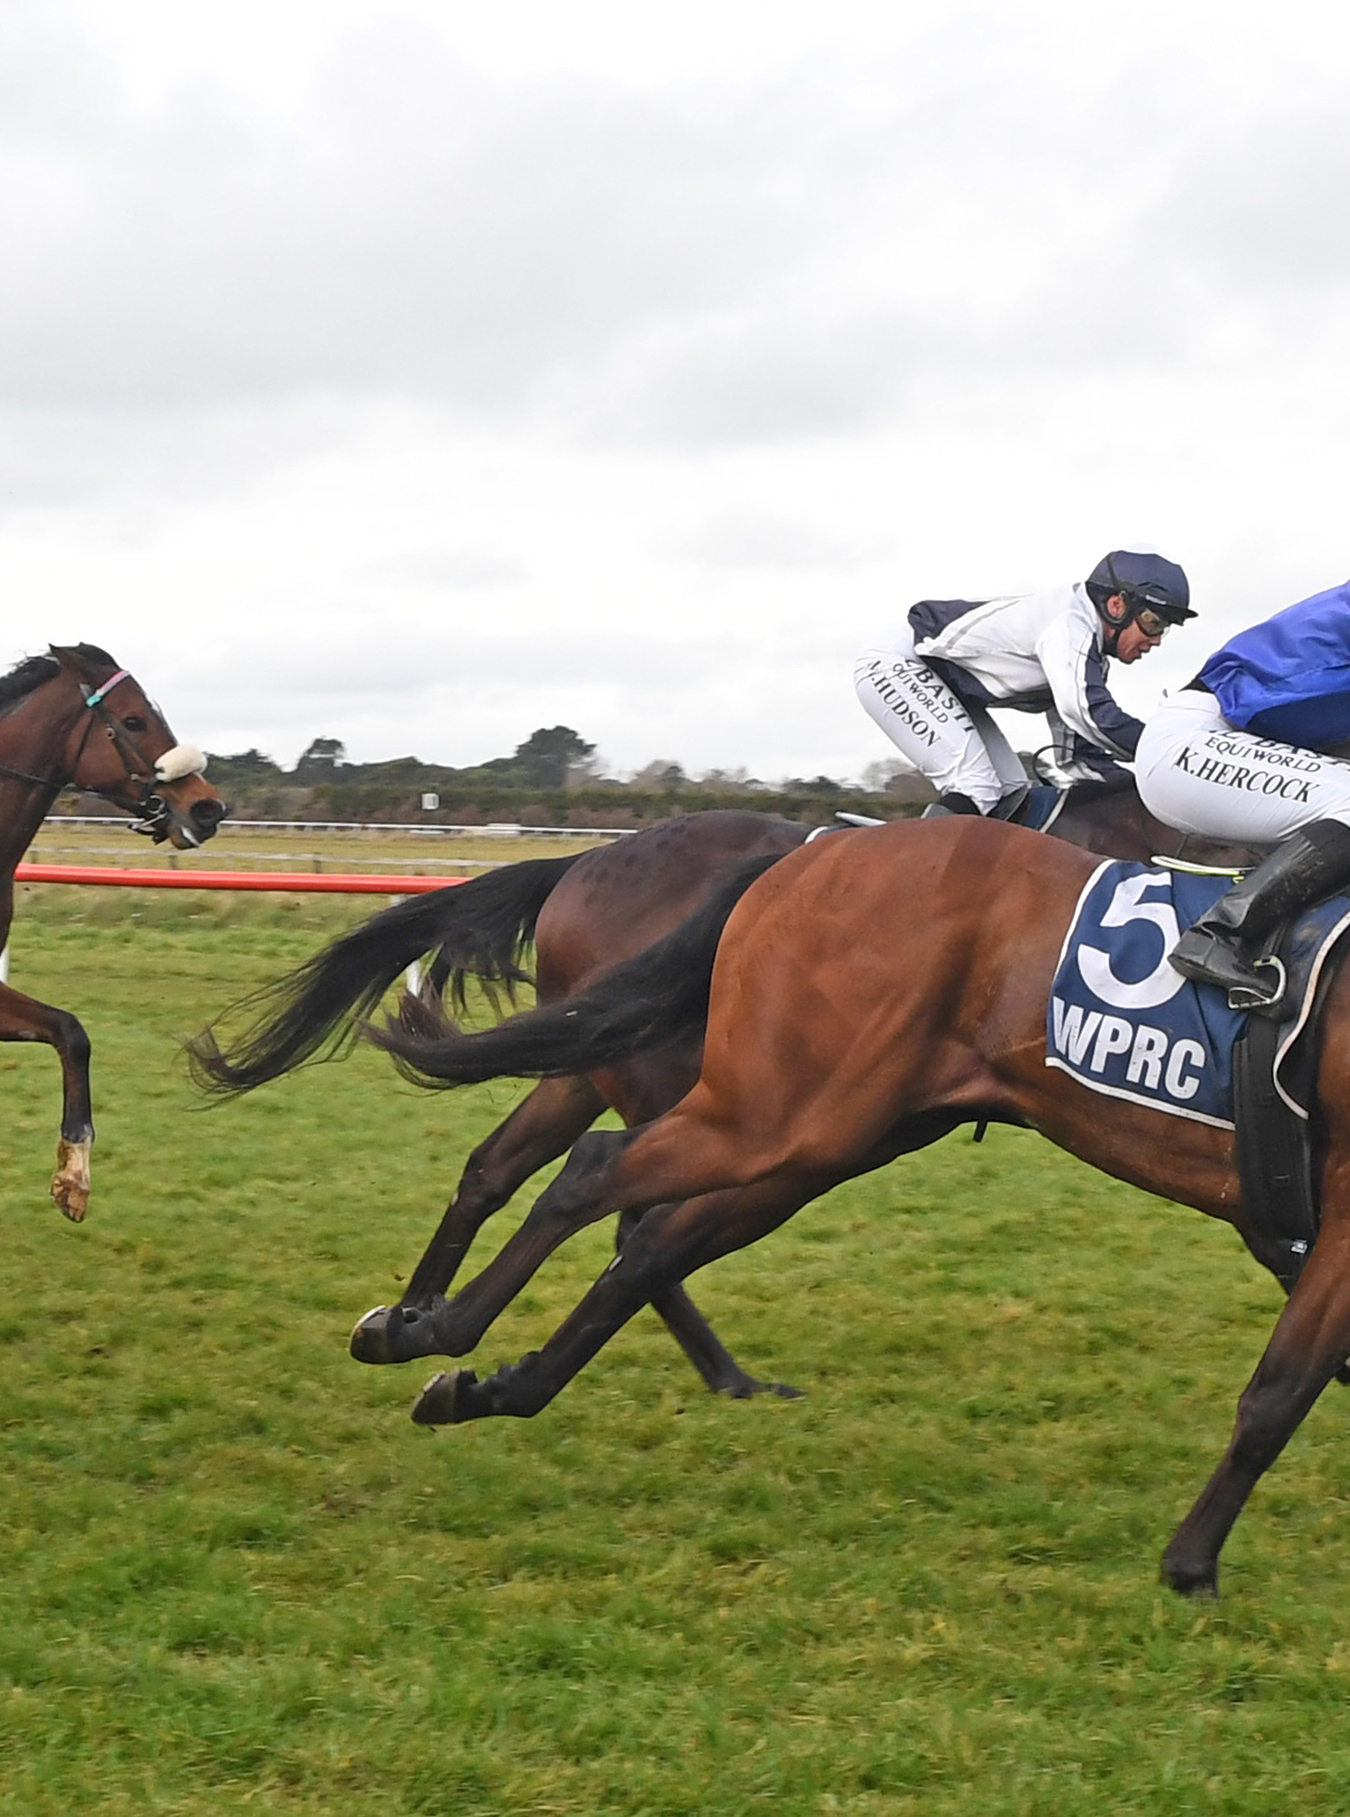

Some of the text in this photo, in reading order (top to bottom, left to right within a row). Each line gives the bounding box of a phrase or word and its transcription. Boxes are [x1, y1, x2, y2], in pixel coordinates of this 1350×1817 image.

[892, 663, 949, 724] QUIWORLD
[1174, 747, 1321, 803] K.HERCOCK
[1204, 736, 1322, 773] EQUIWORLD
[1077, 871, 1188, 1009] 5
[1052, 996, 1206, 1100] WPRC
